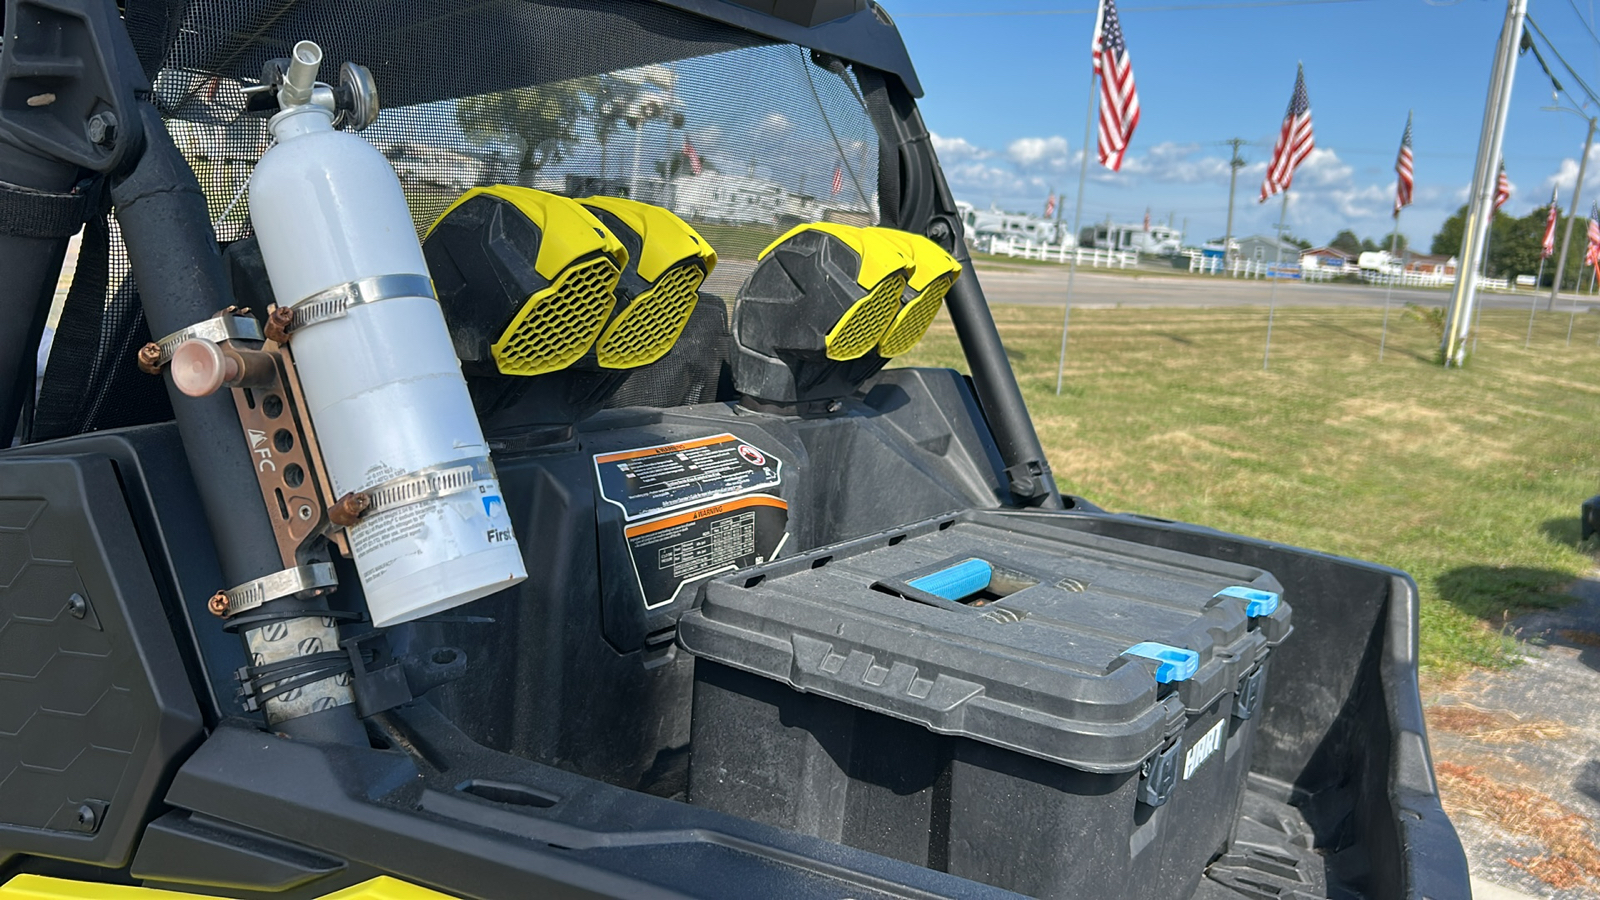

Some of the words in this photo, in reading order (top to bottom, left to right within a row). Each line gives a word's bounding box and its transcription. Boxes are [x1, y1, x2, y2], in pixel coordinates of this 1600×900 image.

[660, 444, 685, 453] WARNING
[698, 505, 723, 518] WARNING
[1183, 718, 1225, 780] HART
